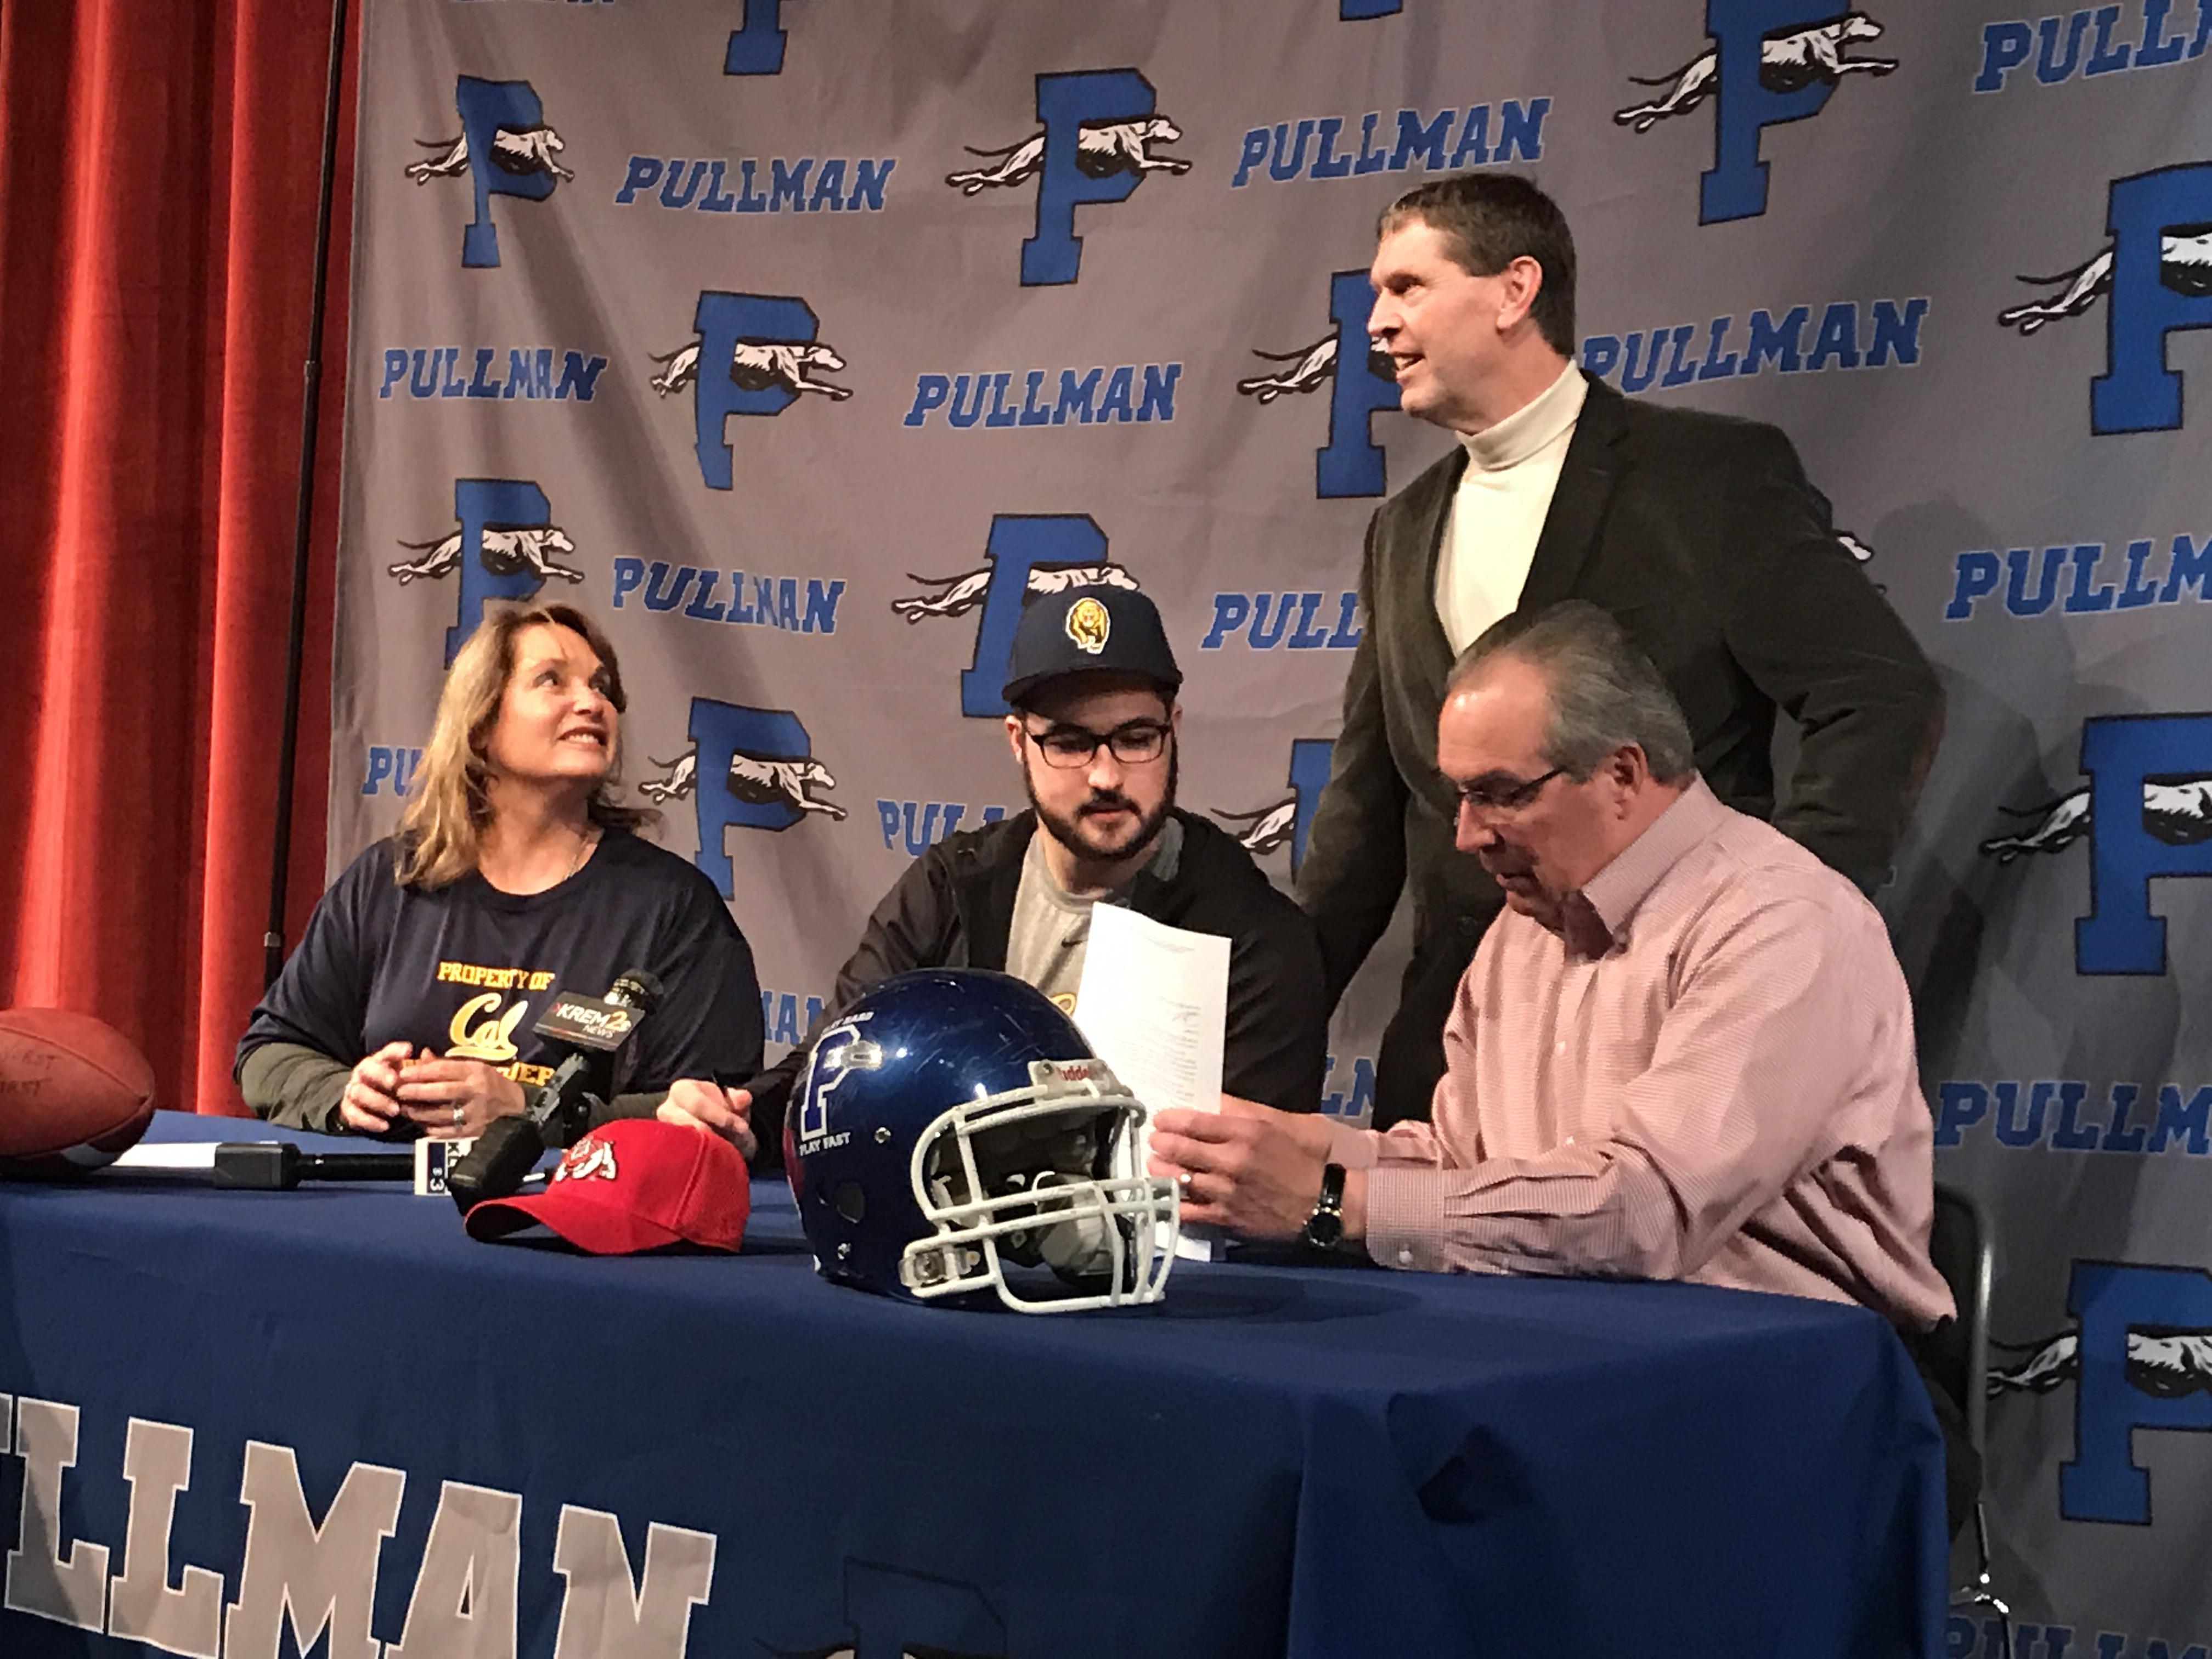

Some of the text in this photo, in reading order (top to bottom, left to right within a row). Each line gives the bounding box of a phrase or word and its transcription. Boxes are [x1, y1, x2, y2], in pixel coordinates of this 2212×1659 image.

[1231, 97, 1551, 188] PULLMAN
[614, 156, 896, 213] PULLMAN
[379, 346, 610, 402] PULLMAN
[1581, 298, 1930, 393] PULLMAN
[902, 363, 1182, 428] PULLMAN
[612, 556, 847, 634] PULLMAN
[438, 962, 555, 990] PROPERTY OF
[445, 992, 528, 1061] Cal
[0, 1392, 716, 1659] LLMAN
